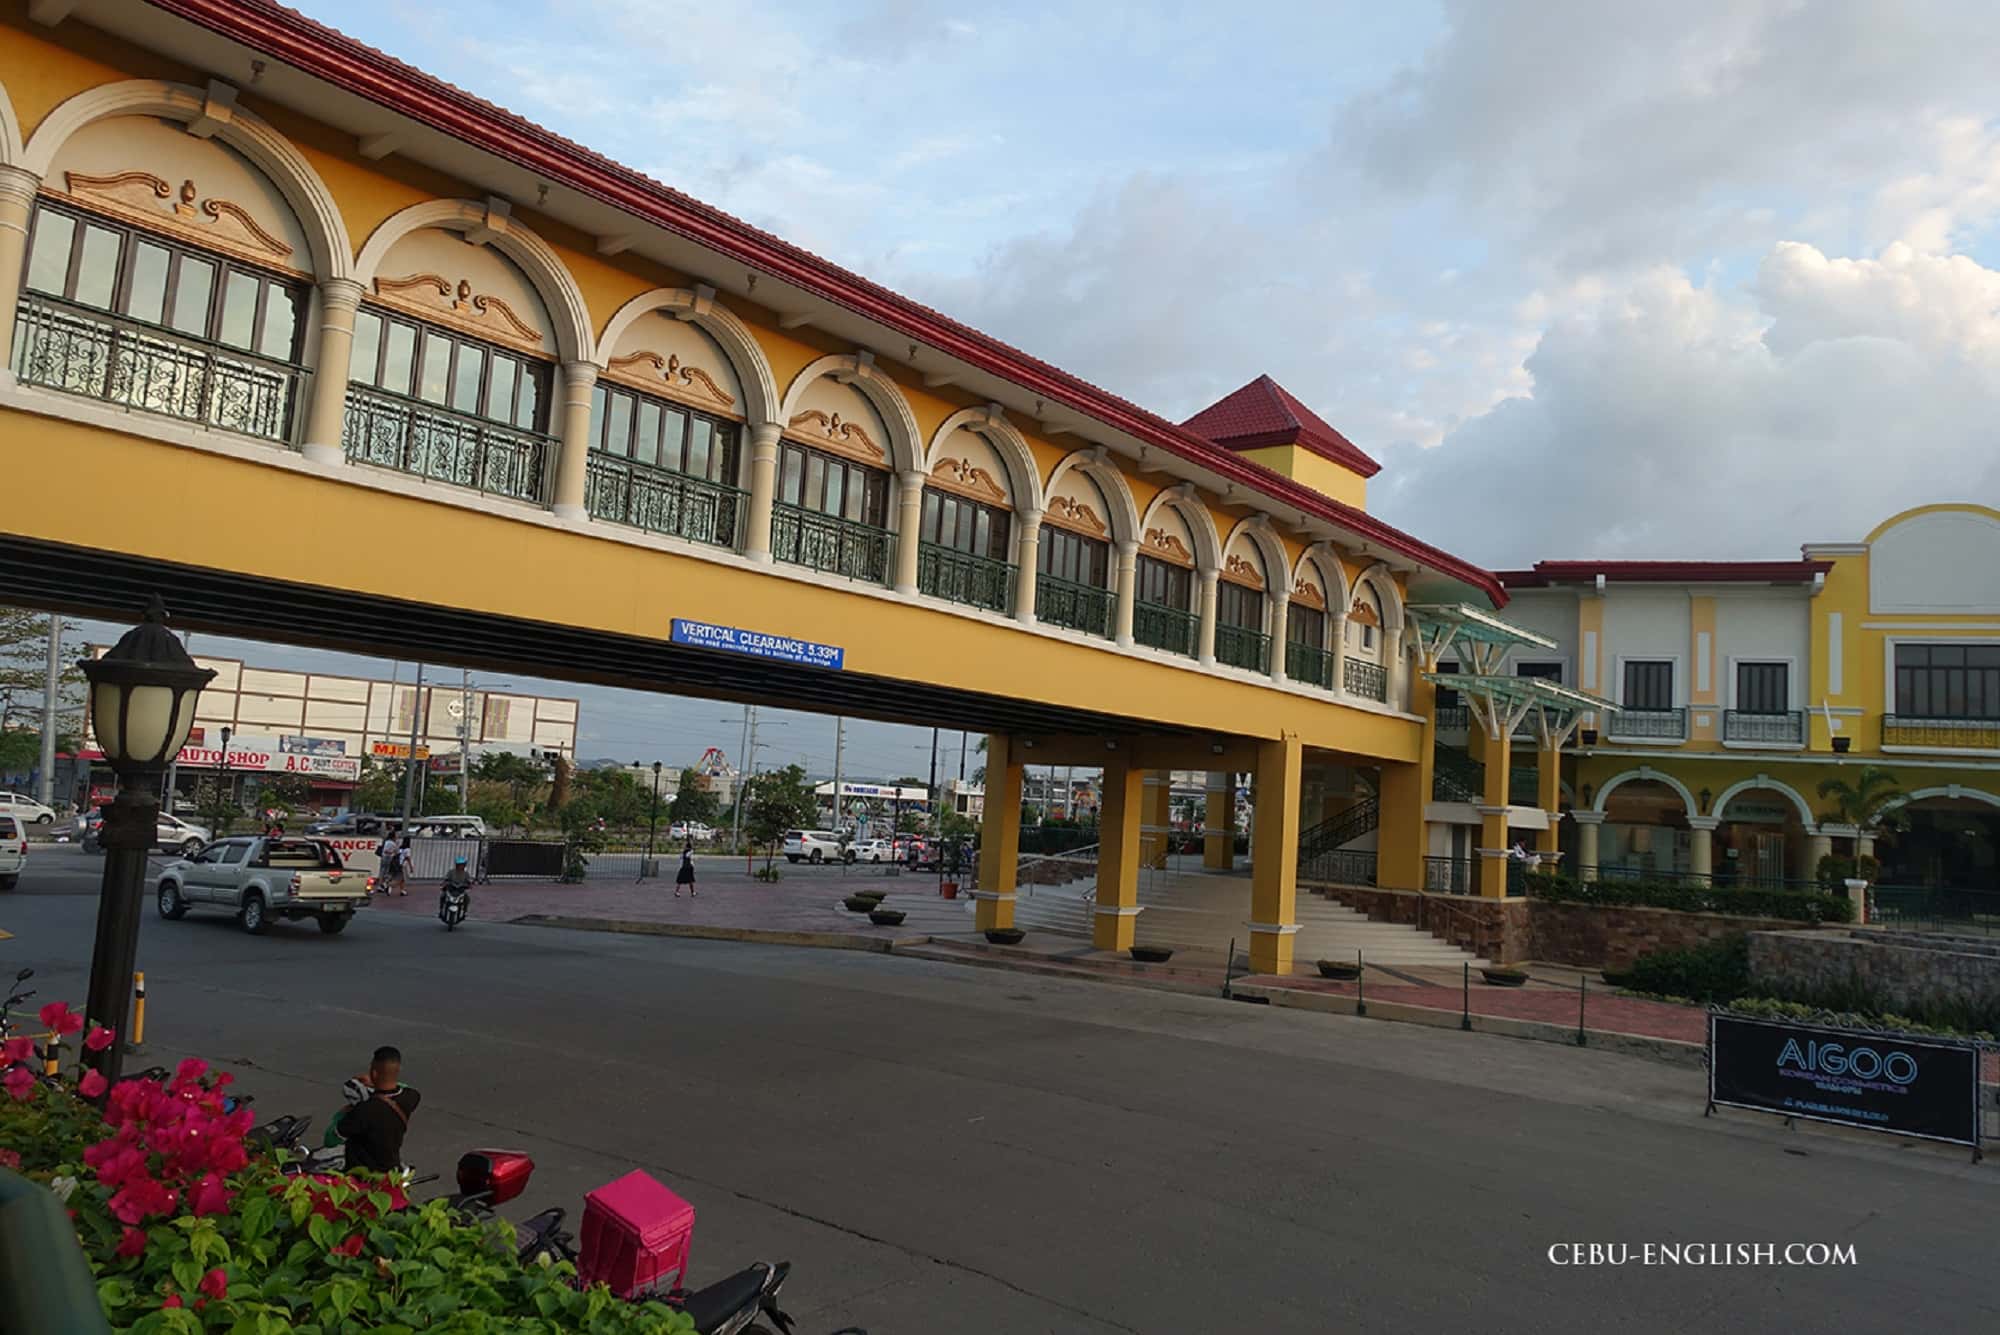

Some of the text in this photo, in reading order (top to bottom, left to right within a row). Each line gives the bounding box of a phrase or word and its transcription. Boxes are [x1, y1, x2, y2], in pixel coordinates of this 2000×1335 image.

[681, 622, 839, 660] VERTICAL CLEARANCE 5.33M
[688, 636, 704, 646] From
[177, 748, 270, 764] AUTO SHOP
[285, 755, 313, 772] A.C.
[1776, 1037, 1918, 1085] AIGOO
